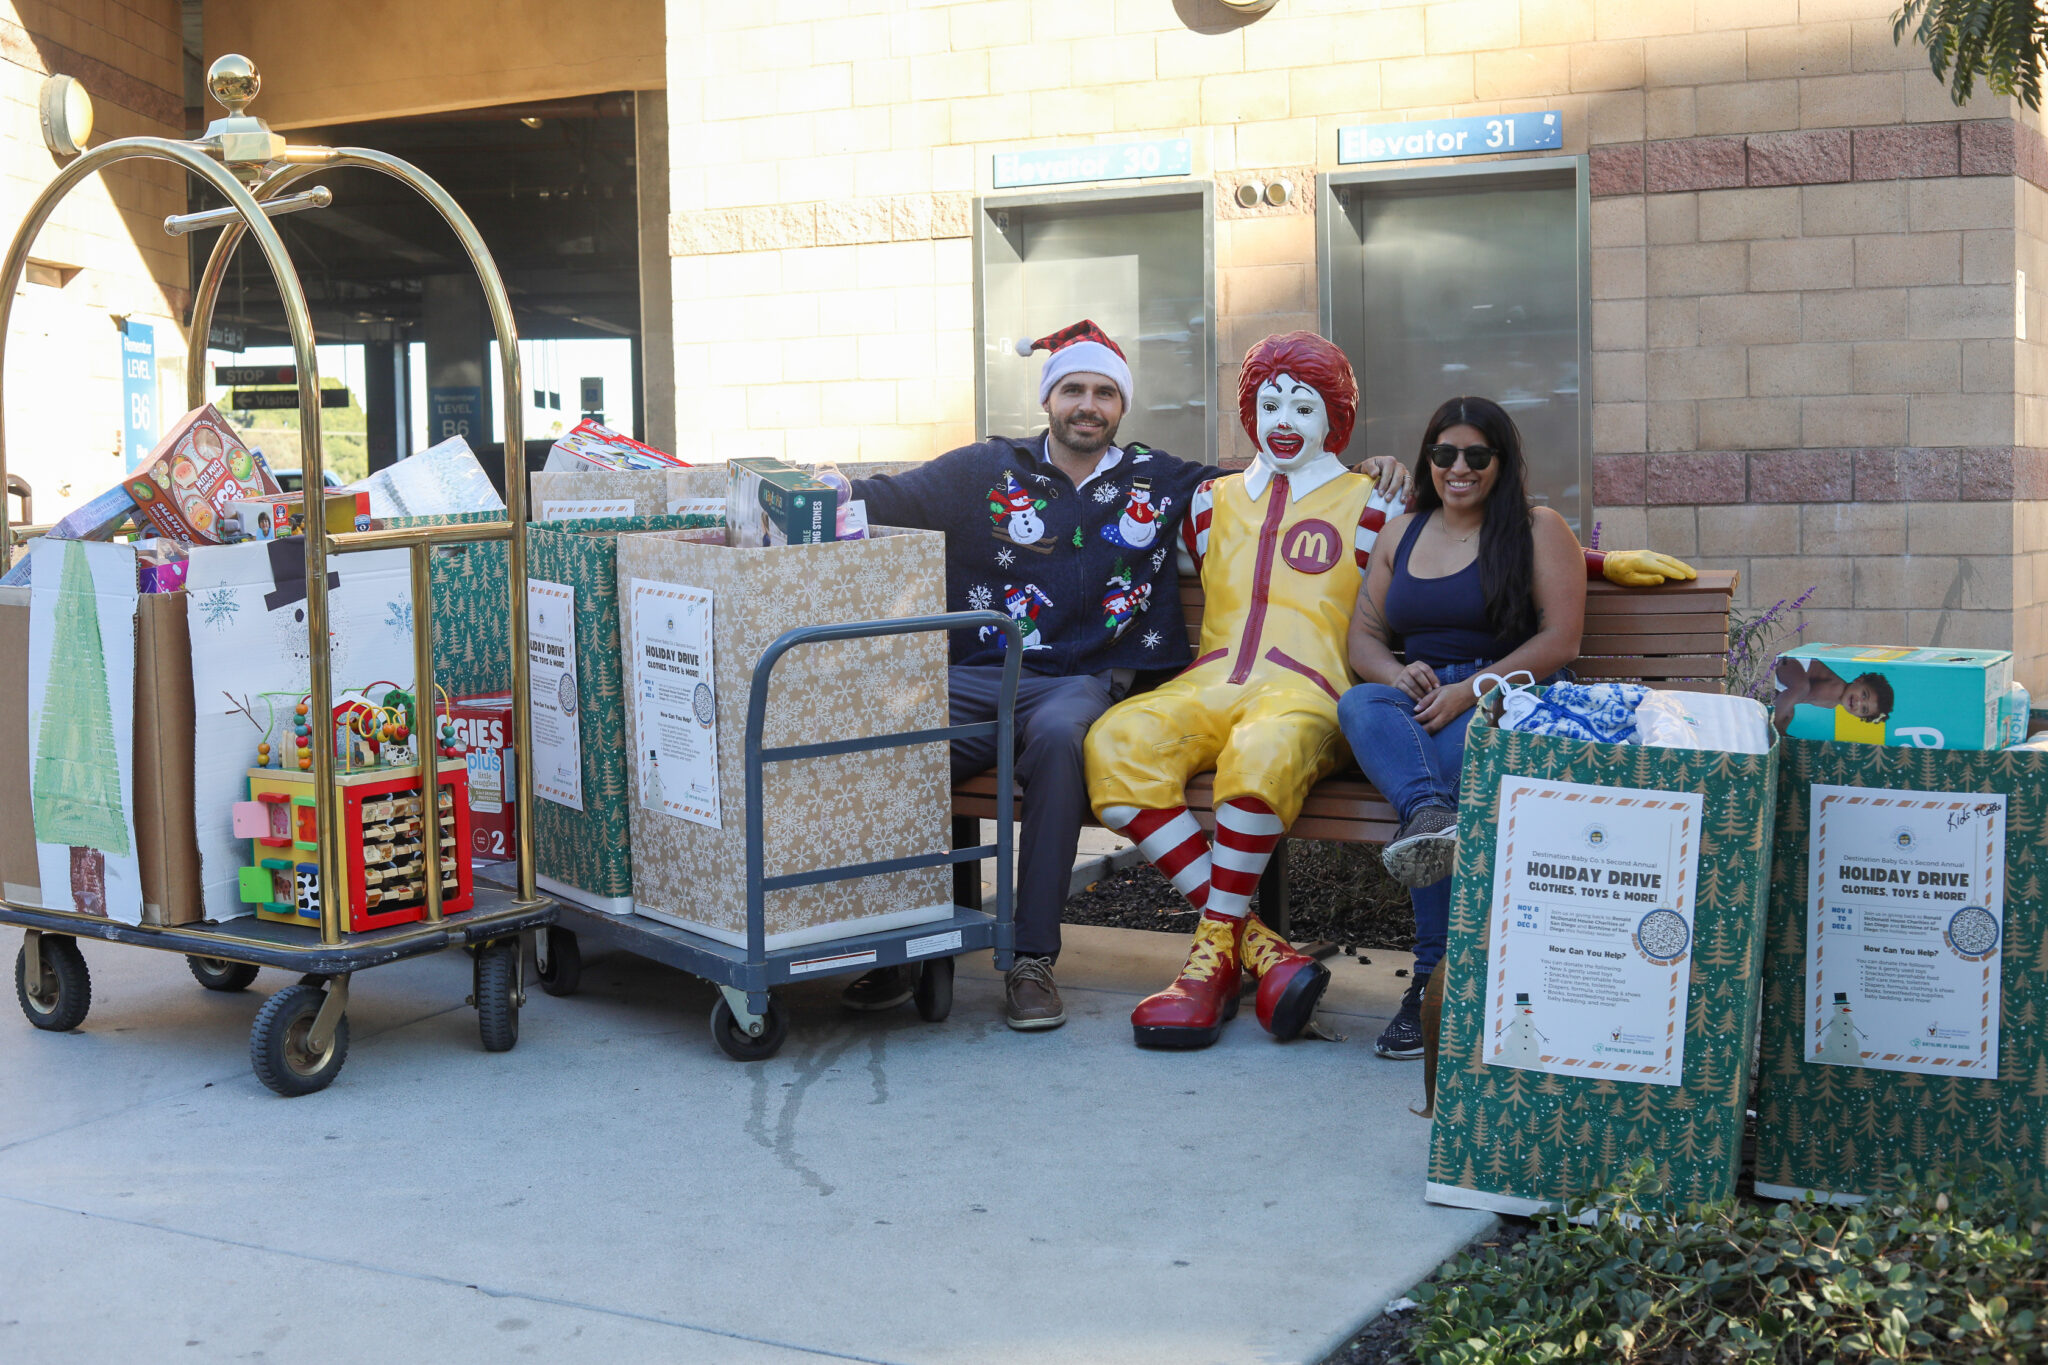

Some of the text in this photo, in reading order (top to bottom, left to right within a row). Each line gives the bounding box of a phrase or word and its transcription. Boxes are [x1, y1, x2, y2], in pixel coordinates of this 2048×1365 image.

[1343, 119, 1515, 159] Elevator 31
[1000, 145, 1160, 183] Elevator 30
[127, 358, 152, 380] LEVEL
[226, 369, 265, 383] STOP
[131, 392, 150, 430] B6
[256, 395, 297, 407] Visitor
[438, 403, 472, 414] LEVEL
[442, 419, 470, 438] B6
[195, 459, 221, 489] DIM SUM
[813, 500, 822, 528] STONES
[803, 529, 811, 544] BLE
[547, 643, 565, 658] DRIVE
[645, 644, 698, 666] HOLIDAY DRIVE
[467, 748, 501, 774] plus
[491, 830, 505, 855] 2
[1532, 850, 1570, 860] Destination
[1571, 854, 1587, 862] Baby
[1606, 858, 1631, 866] Second
[1527, 861, 1661, 889] HOLIDAY DRIVE
[1839, 865, 1969, 887] HOLIDAY DRIVE
[1528, 881, 1657, 903] CLOTHES, TOYS & MORE!
[1841, 884, 1966, 901] CLOTHES, TOYS & MORE!
[1517, 904, 1532, 912] NOV
[1604, 951, 1626, 960] Help?
[1864, 944, 1880, 952] How
[1900, 947, 1914, 955] You
[1917, 948, 1938, 957] Help?
